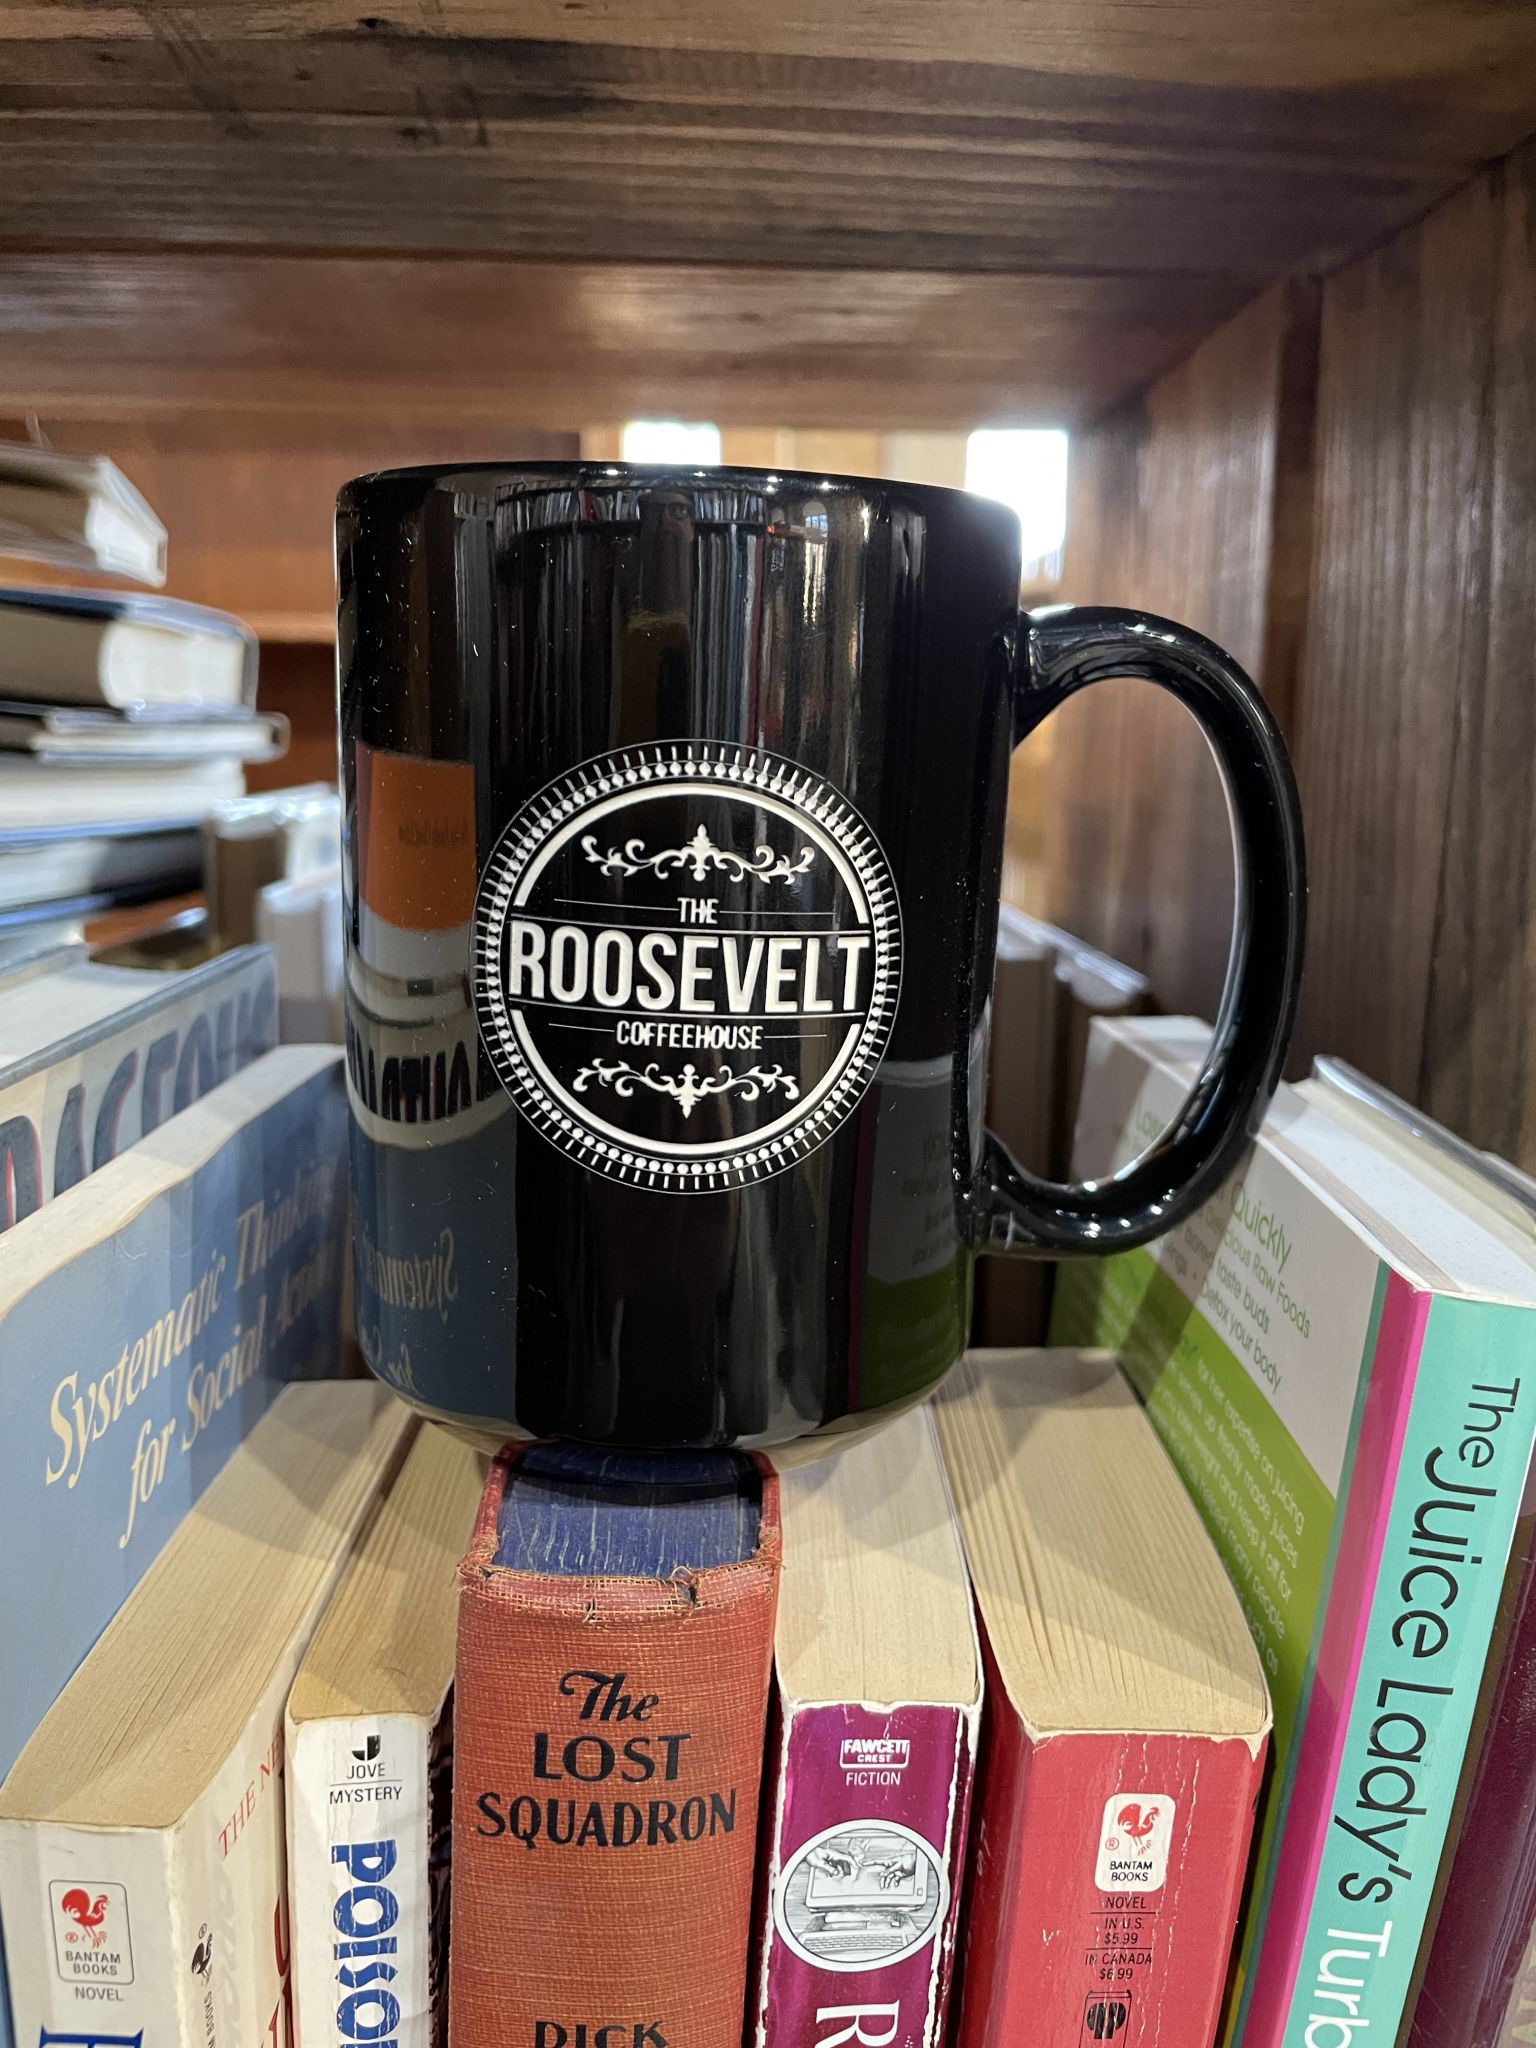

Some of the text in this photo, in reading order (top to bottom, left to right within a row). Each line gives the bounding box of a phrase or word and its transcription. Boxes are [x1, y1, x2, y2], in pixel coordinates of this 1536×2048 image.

[677, 898, 719, 925] THE
[510, 920, 871, 1013] ROOSEVELT
[616, 1020, 764, 1050] COFFEEHOUSE
[1231, 1183, 1292, 1274] Quickly
[1216, 1257, 1242, 1300] taste
[1243, 1286, 1269, 1334] buds
[1252, 1253, 1276, 1295] Raw
[1277, 1280, 1311, 1339] Foods
[46, 1247, 226, 1489] Systematic
[1229, 1313, 1253, 1353] your
[1253, 1339, 1281, 1394] body
[119, 1418, 176, 1550] for
[181, 1295, 267, 1453] Social
[1458, 1377, 1521, 1469] The
[1271, 1472, 1305, 1535] juicing
[1269, 1512, 1298, 1569] juices
[1391, 1446, 1498, 1658] Juice
[1278, 1570, 1292, 1602] for
[560, 1670, 660, 1722] The
[533, 1732, 691, 1783] LOST
[843, 1739, 911, 1754] FAWCETT
[857, 1754, 892, 1763] CREST
[346, 1762, 386, 1780] JOVE
[845, 1771, 901, 1786] FICTION
[329, 1786, 403, 1805] MYSTERY
[1334, 1678, 1454, 1904] Lady's
[218, 1780, 255, 1858] THE
[476, 1787, 737, 1851] SQUADRON
[1110, 1860, 1153, 1871] BANTAM
[1111, 1872, 1149, 1882] BOOKS
[1105, 1896, 1147, 1909] NOVEL
[1104, 1917, 1145, 1930] IN U.S.
[1104, 1932, 1139, 1945] $5.99
[65, 1951, 121, 1964] BANTAM
[331, 1839, 401, 2048] POISO
[1085, 1953, 1152, 1966] IN CANADA
[73, 1963, 118, 1976] BOOKS
[1099, 1967, 1133, 1980] $6.99
[75, 1986, 124, 2001] NOVEL
